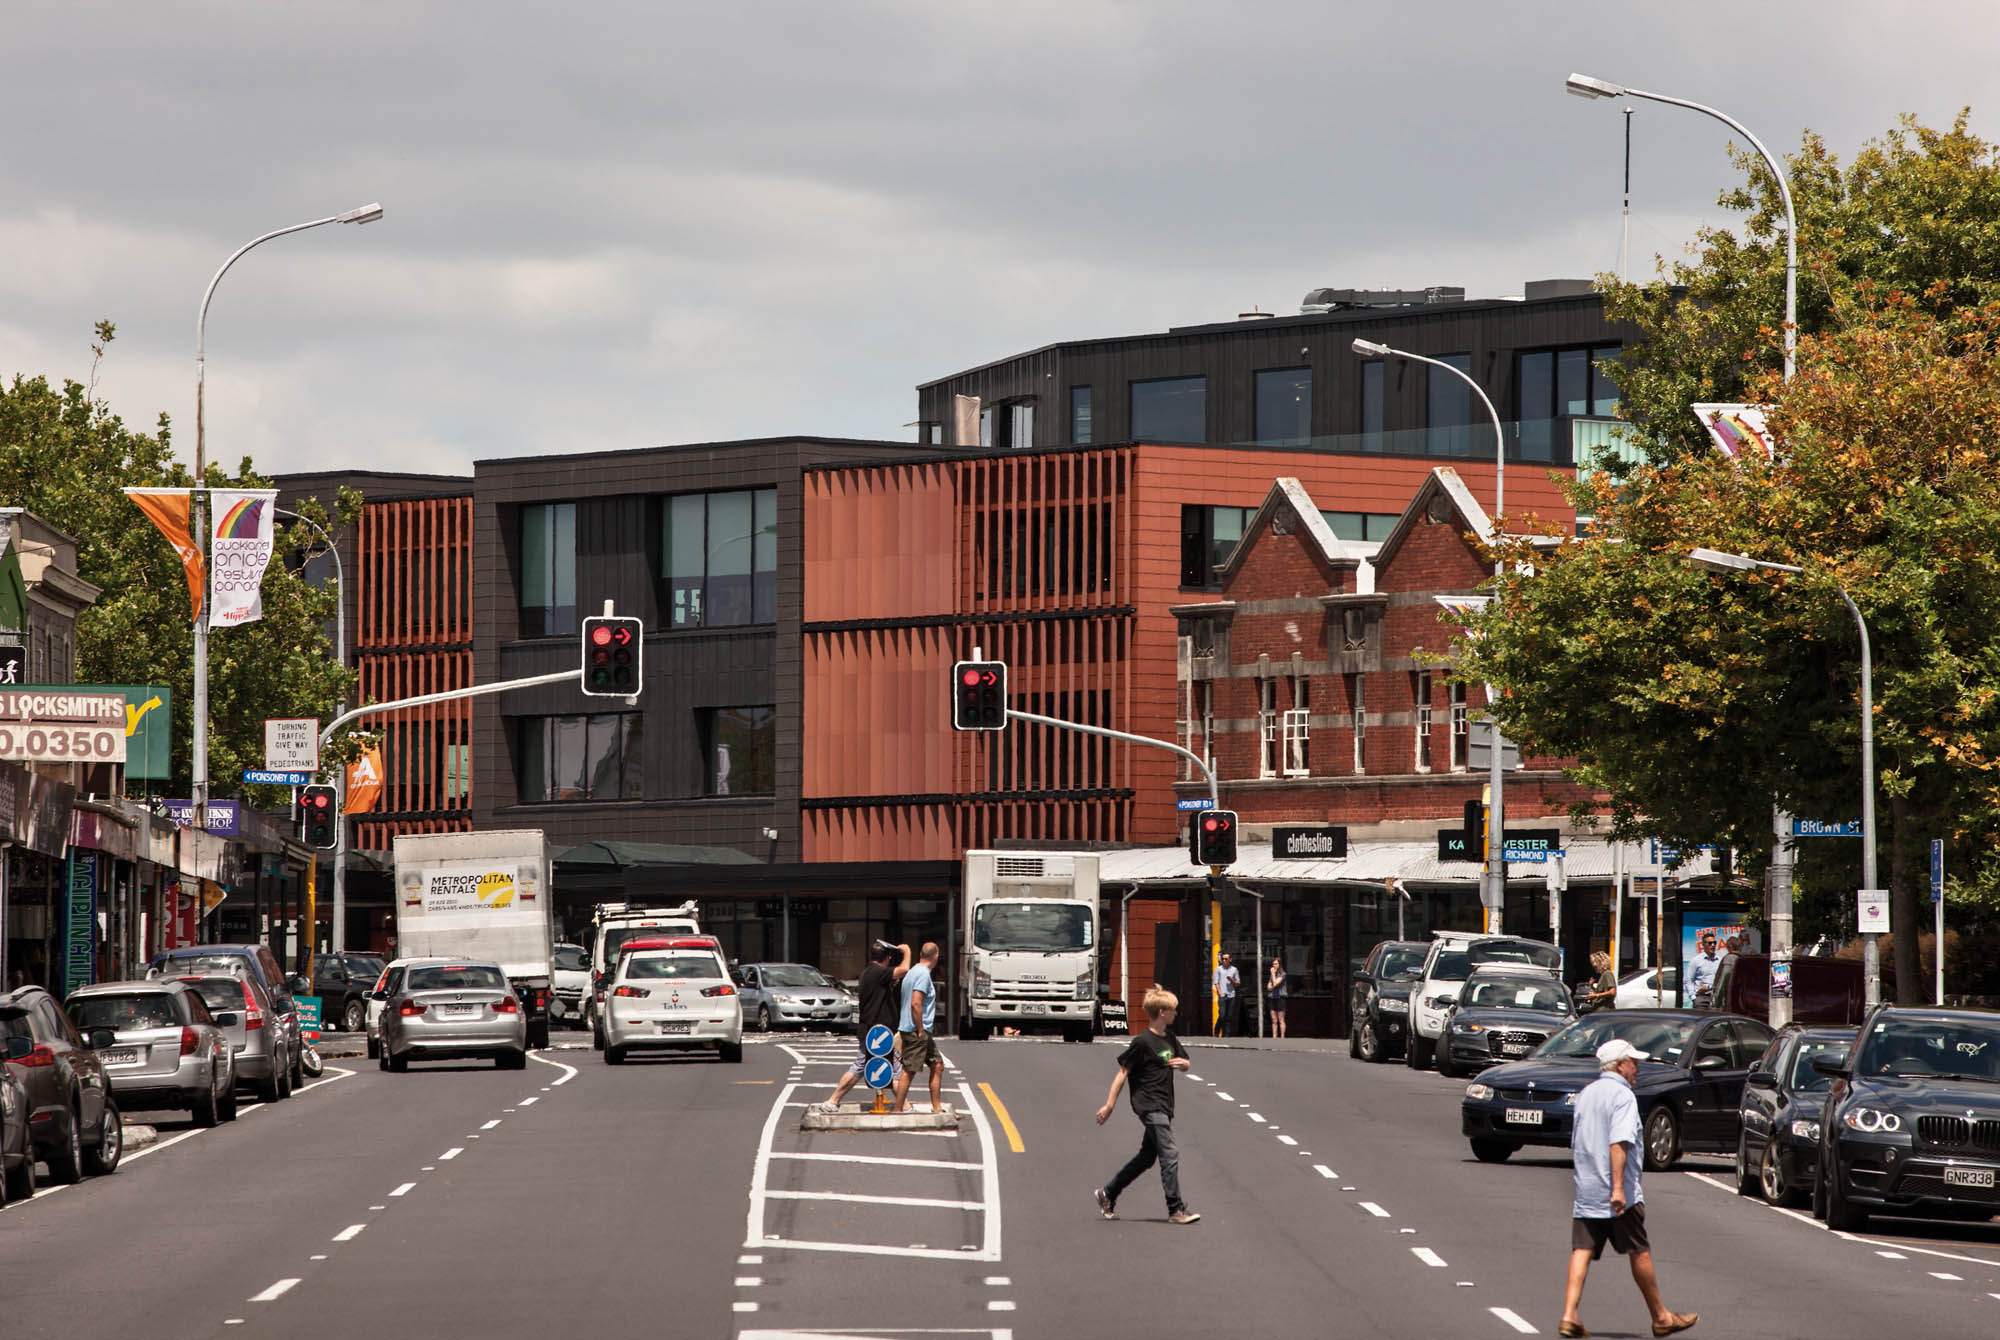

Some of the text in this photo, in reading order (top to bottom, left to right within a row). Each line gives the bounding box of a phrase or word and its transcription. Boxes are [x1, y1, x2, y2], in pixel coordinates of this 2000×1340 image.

[215, 551, 268, 570] pride
[277, 723, 307, 731] TURNING
[269, 760, 314, 768] PEDESTRIANS
[251, 772, 300, 783] PONSONBY RD
[182, 809, 232, 818] WEN'S
[1287, 832, 1333, 853] clothesline
[1505, 850, 1544, 860] RICHMOND
[431, 874, 514, 886] METROPOLITAN
[430, 885, 476, 895] RENTALS
[1105, 1020, 1128, 1029] OPEN
[1507, 1110, 1540, 1123] HEH141
[1946, 1170, 1993, 1185] GNR338
